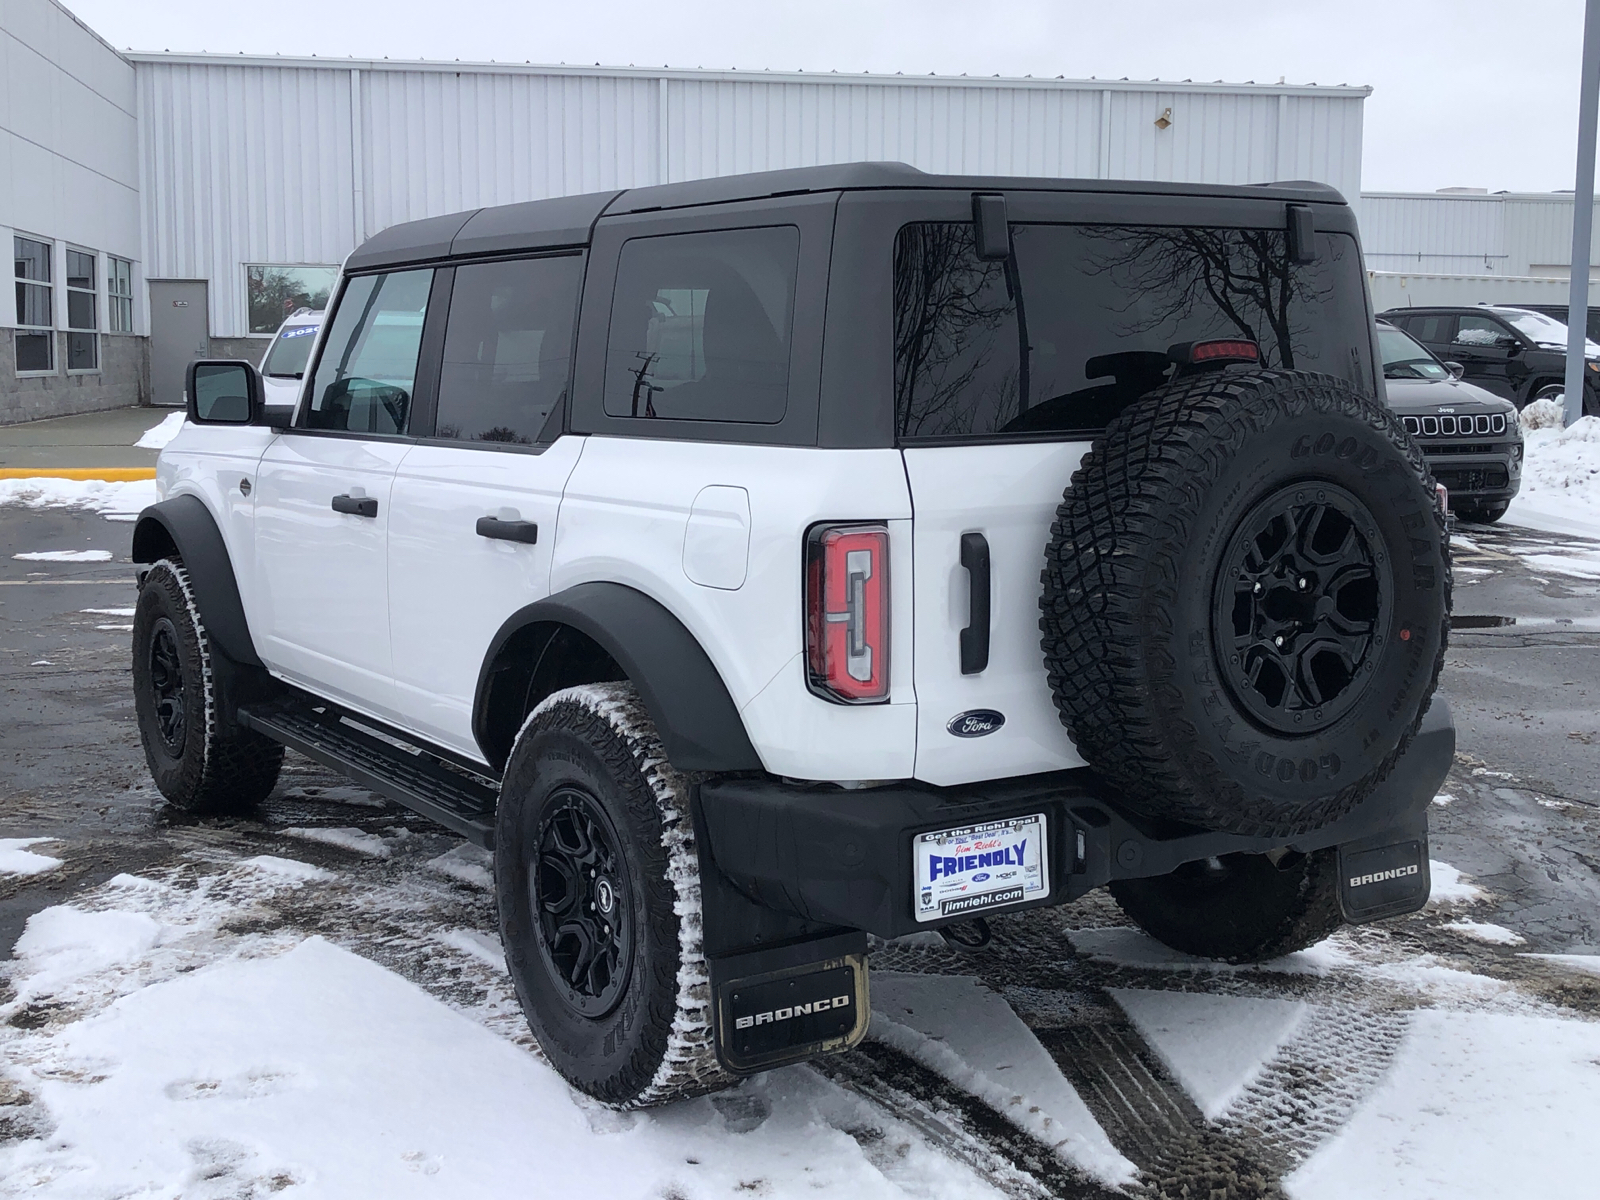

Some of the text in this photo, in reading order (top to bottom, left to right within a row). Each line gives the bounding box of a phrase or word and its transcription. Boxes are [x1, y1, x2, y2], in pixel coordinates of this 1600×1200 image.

[962, 716, 993, 733] Ford
[951, 828, 971, 838] the
[974, 819, 1005, 832] Riehl
[1008, 816, 1035, 827] Deal
[929, 838, 1027, 882] FRIENDLY
[955, 845, 971, 856] Jim
[996, 871, 1017, 880] MOKE
[1349, 864, 1418, 887] BRONCO
[944, 890, 1022, 914] jimriehl.com
[735, 995, 849, 1030] BRONCO
